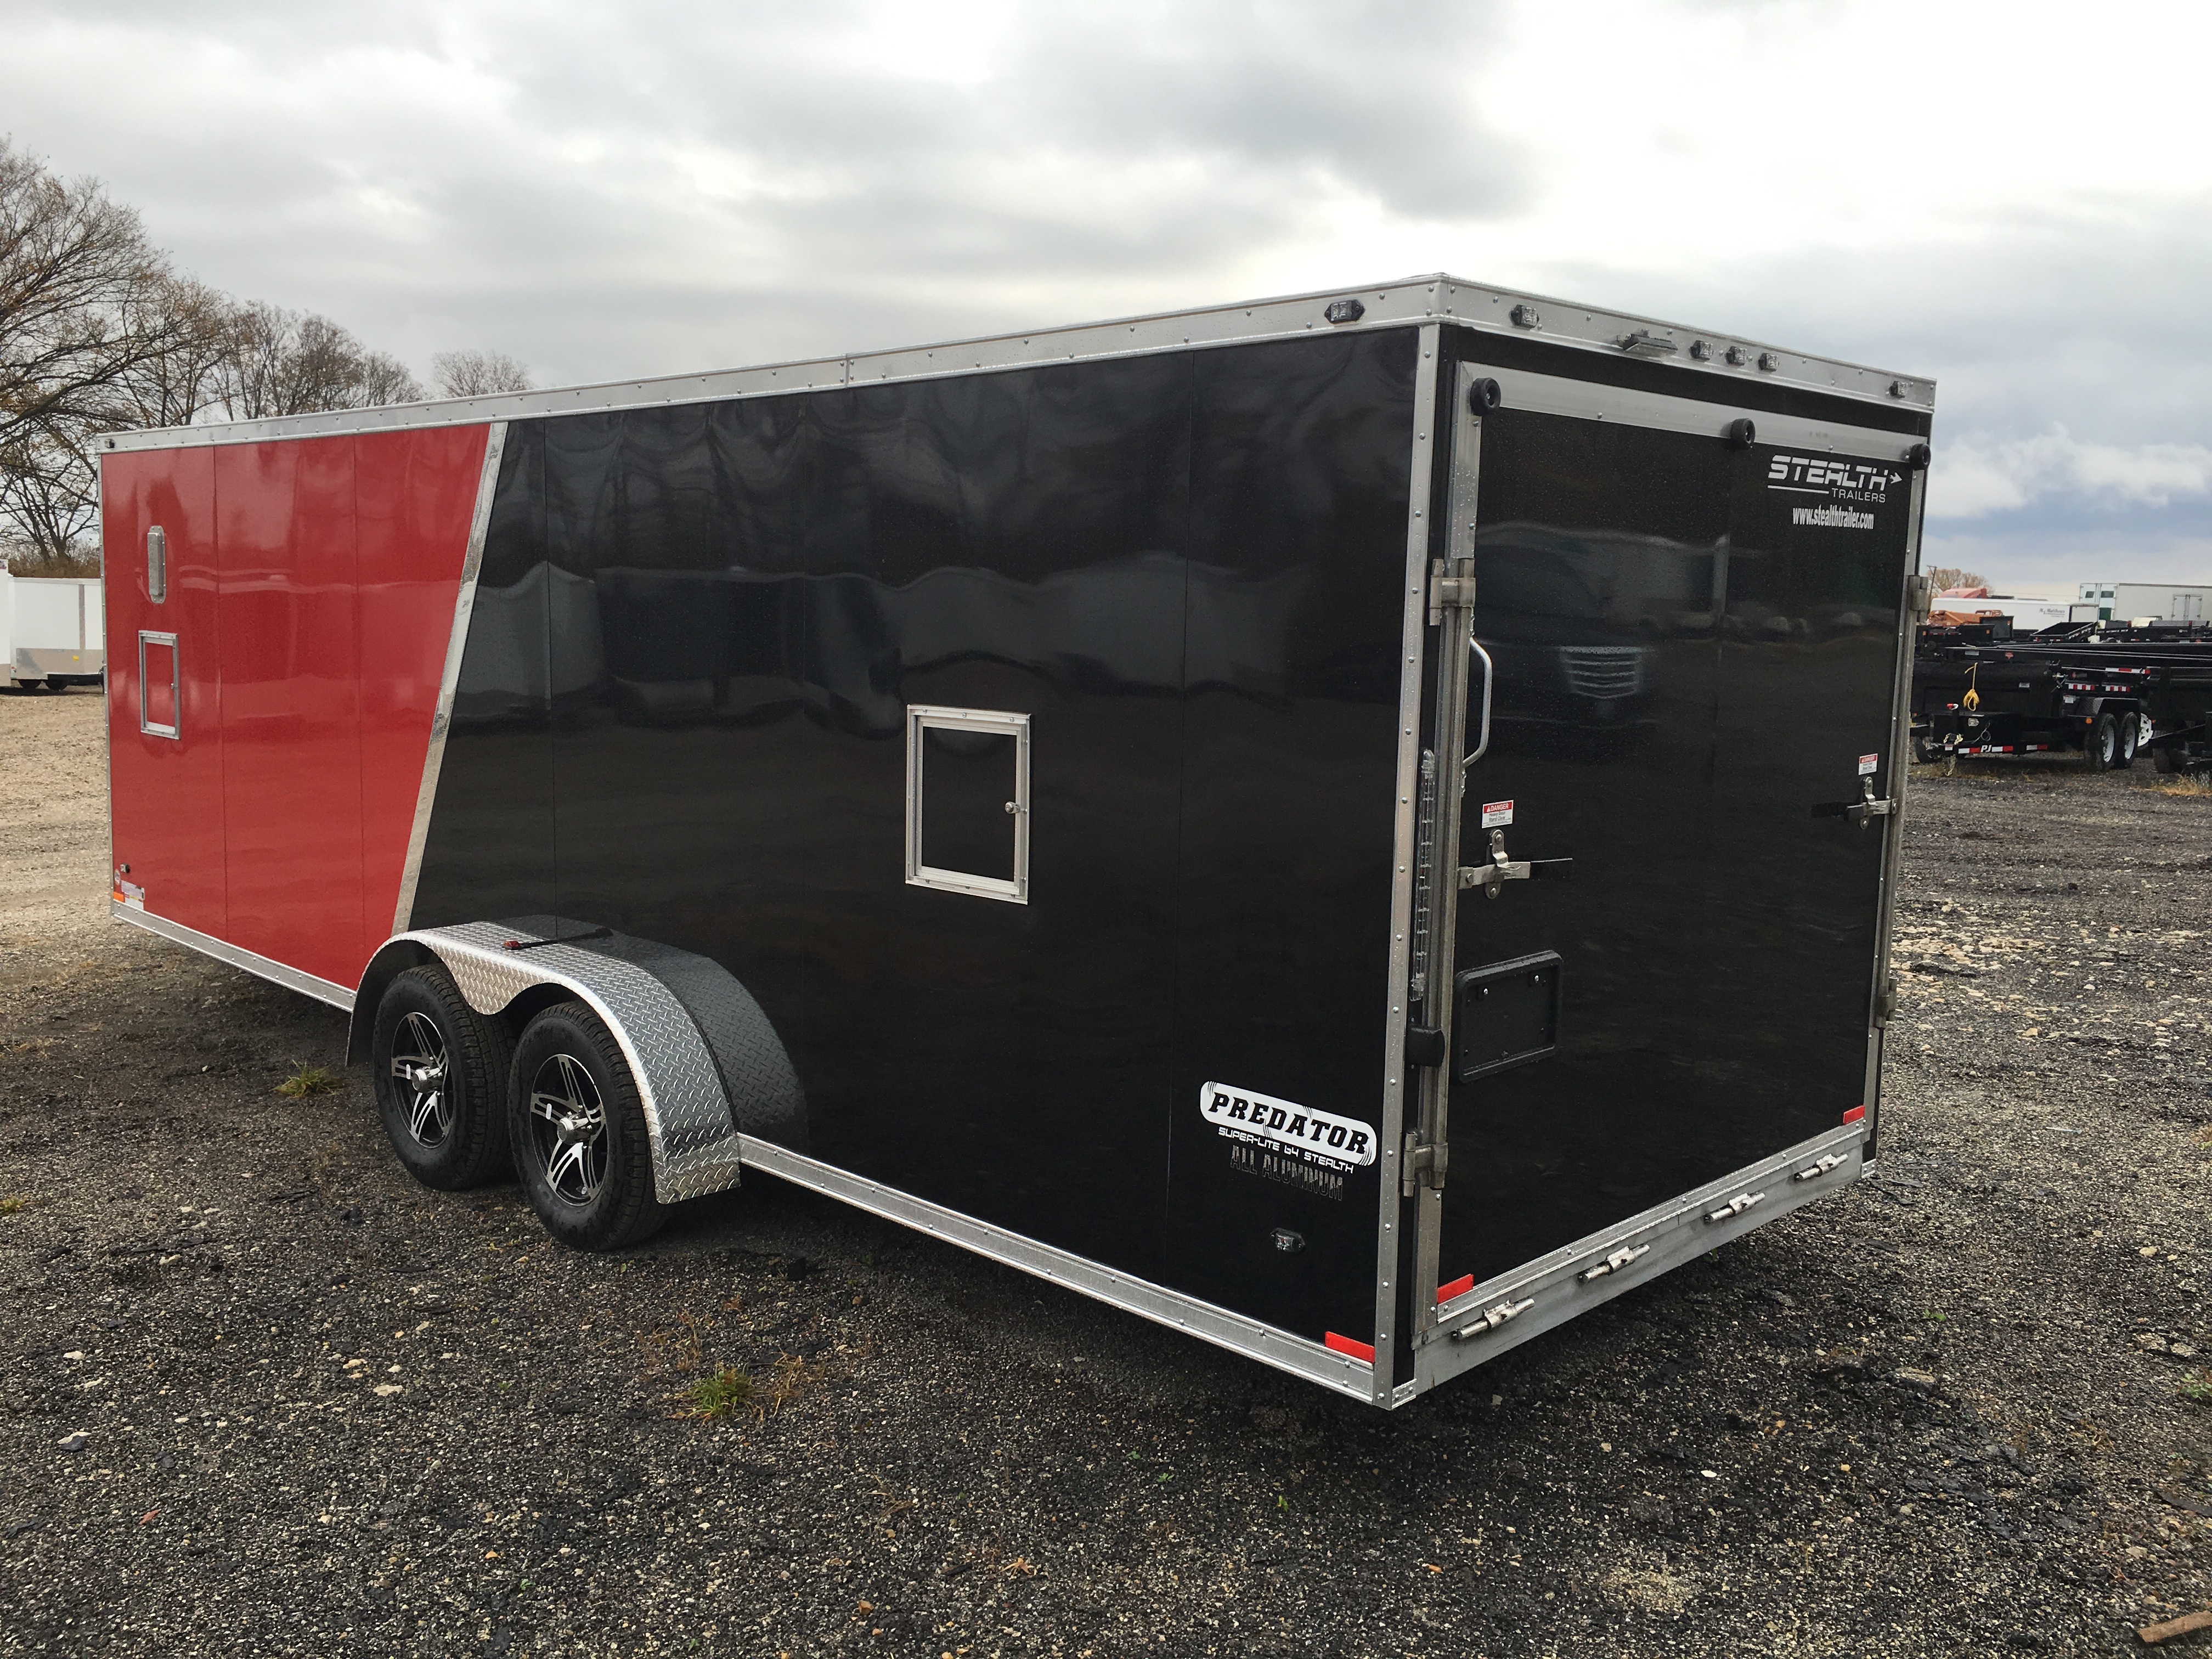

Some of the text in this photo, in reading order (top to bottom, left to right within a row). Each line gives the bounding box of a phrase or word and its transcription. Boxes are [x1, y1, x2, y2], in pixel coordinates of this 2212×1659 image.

[1768, 455, 1888, 491] STEALTH
[1832, 488, 1886, 503] TRAILERS
[1793, 504, 1874, 529] www.stealthtrailer.com
[1980, 744, 1992, 753] PJ
[1207, 1092, 1370, 1155] PREDATOR
[1218, 1126, 1280, 1152] SUPER-LITE
[1304, 1151, 1354, 1174] STEALTH
[1230, 1144, 1343, 1201] ALL ALUMINUM
